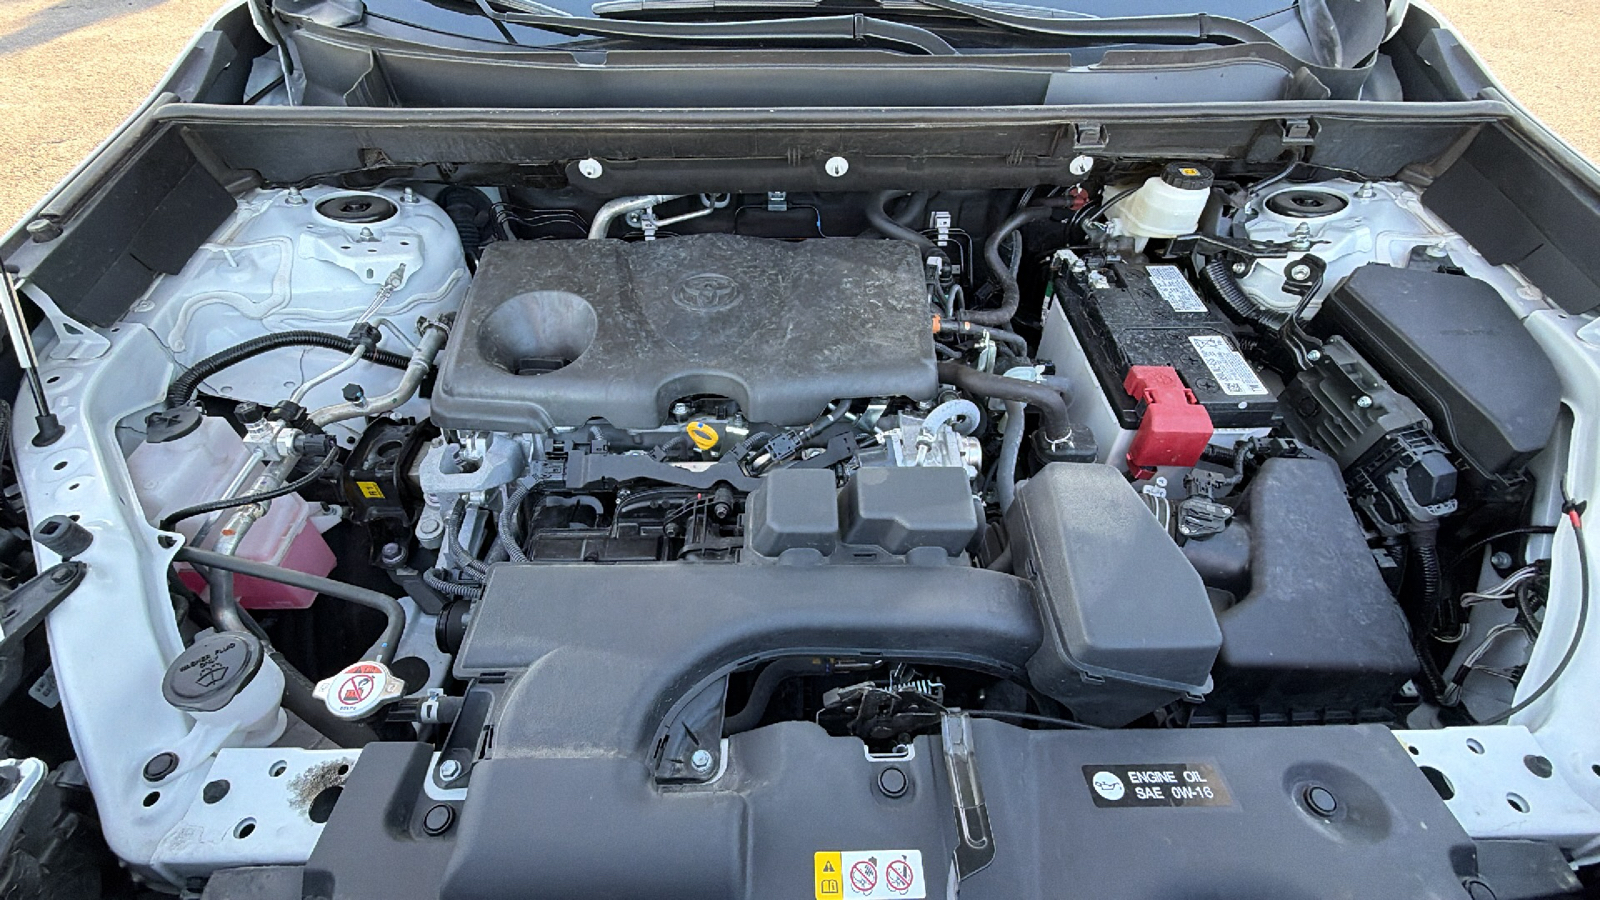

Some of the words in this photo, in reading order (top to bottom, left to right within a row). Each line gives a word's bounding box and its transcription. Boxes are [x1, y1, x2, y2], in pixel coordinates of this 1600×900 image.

[215, 643, 235, 655] FLUID
[200, 655, 219, 668] ONLY
[1127, 771, 1178, 783] ENGINE
[1183, 771, 1207, 783] OIL
[1135, 786, 1165, 799] SAE
[1171, 786, 1214, 799] 0W-16
